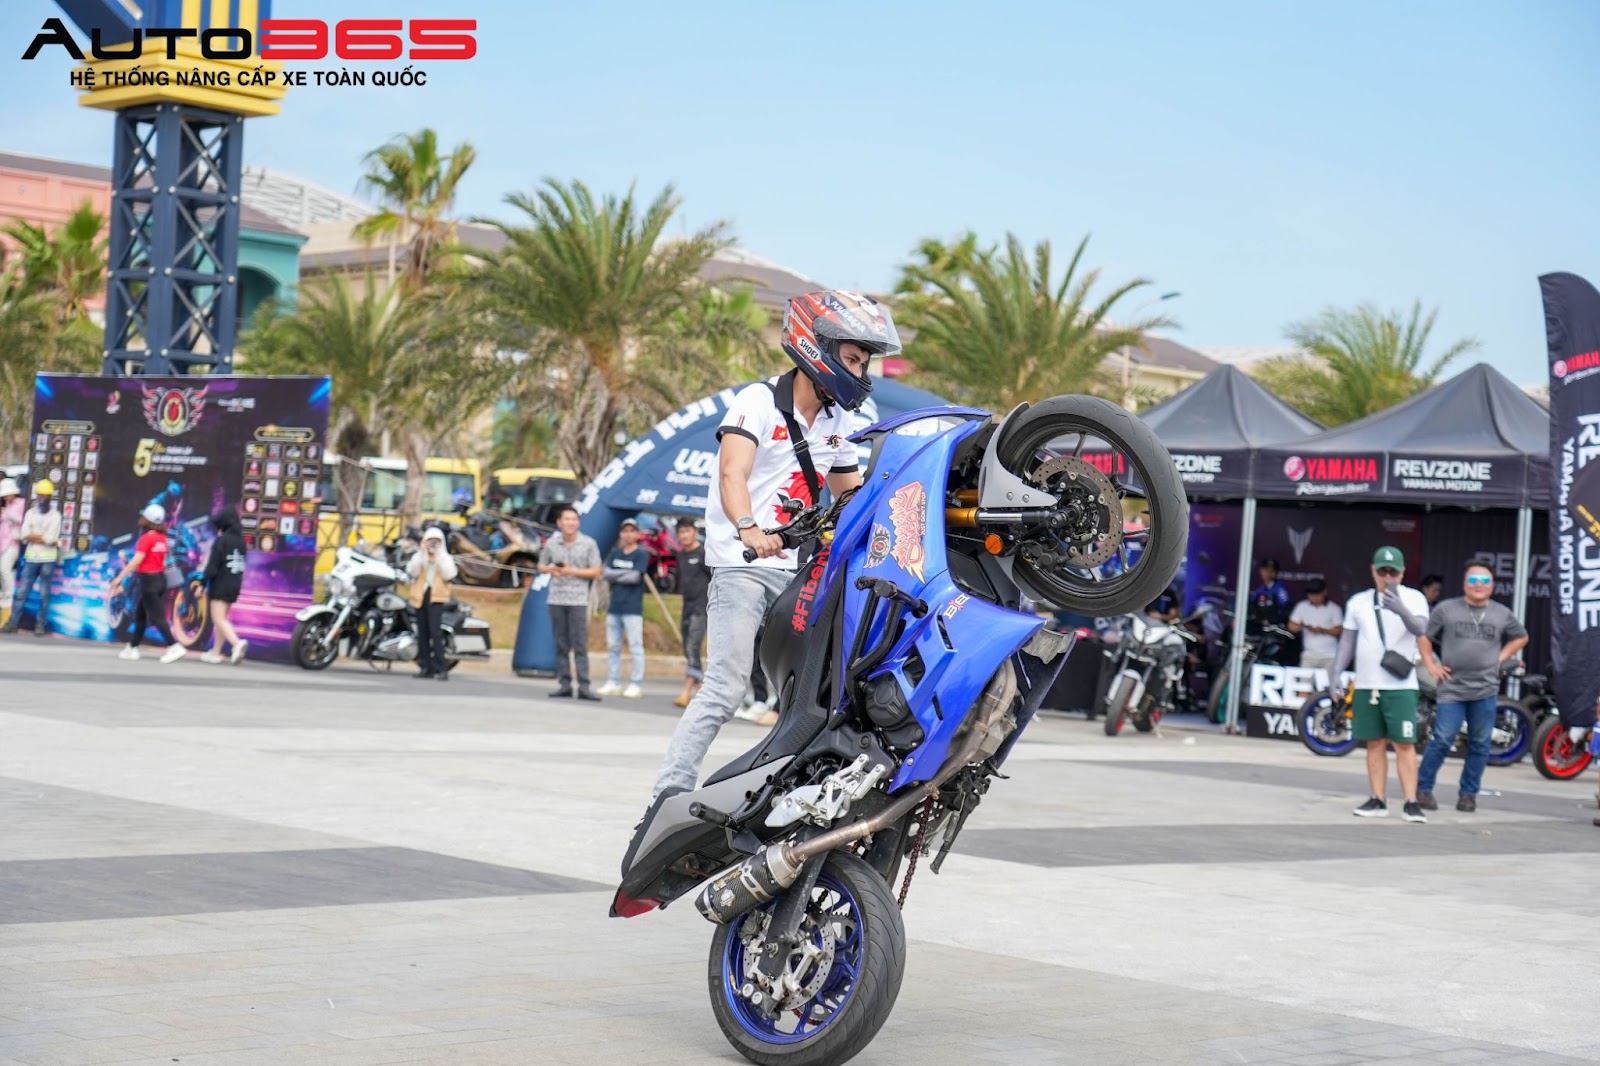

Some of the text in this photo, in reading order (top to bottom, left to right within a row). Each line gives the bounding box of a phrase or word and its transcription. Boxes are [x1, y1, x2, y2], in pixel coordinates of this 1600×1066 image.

[800, 339, 819, 359] SHOEI
[1567, 350, 1600, 373] YAMAH
[1170, 454, 1223, 473] ZONE
[1305, 457, 1378, 481] YAMAHA
[1393, 459, 1492, 480] REVZONE
[1402, 478, 1483, 492] YAMAHA MOTOR
[1578, 413, 1600, 633] REONE
[1559, 534, 1575, 615] MOTOR
[1495, 582, 1550, 599] AMHA
[1402, 721, 1414, 738] B
